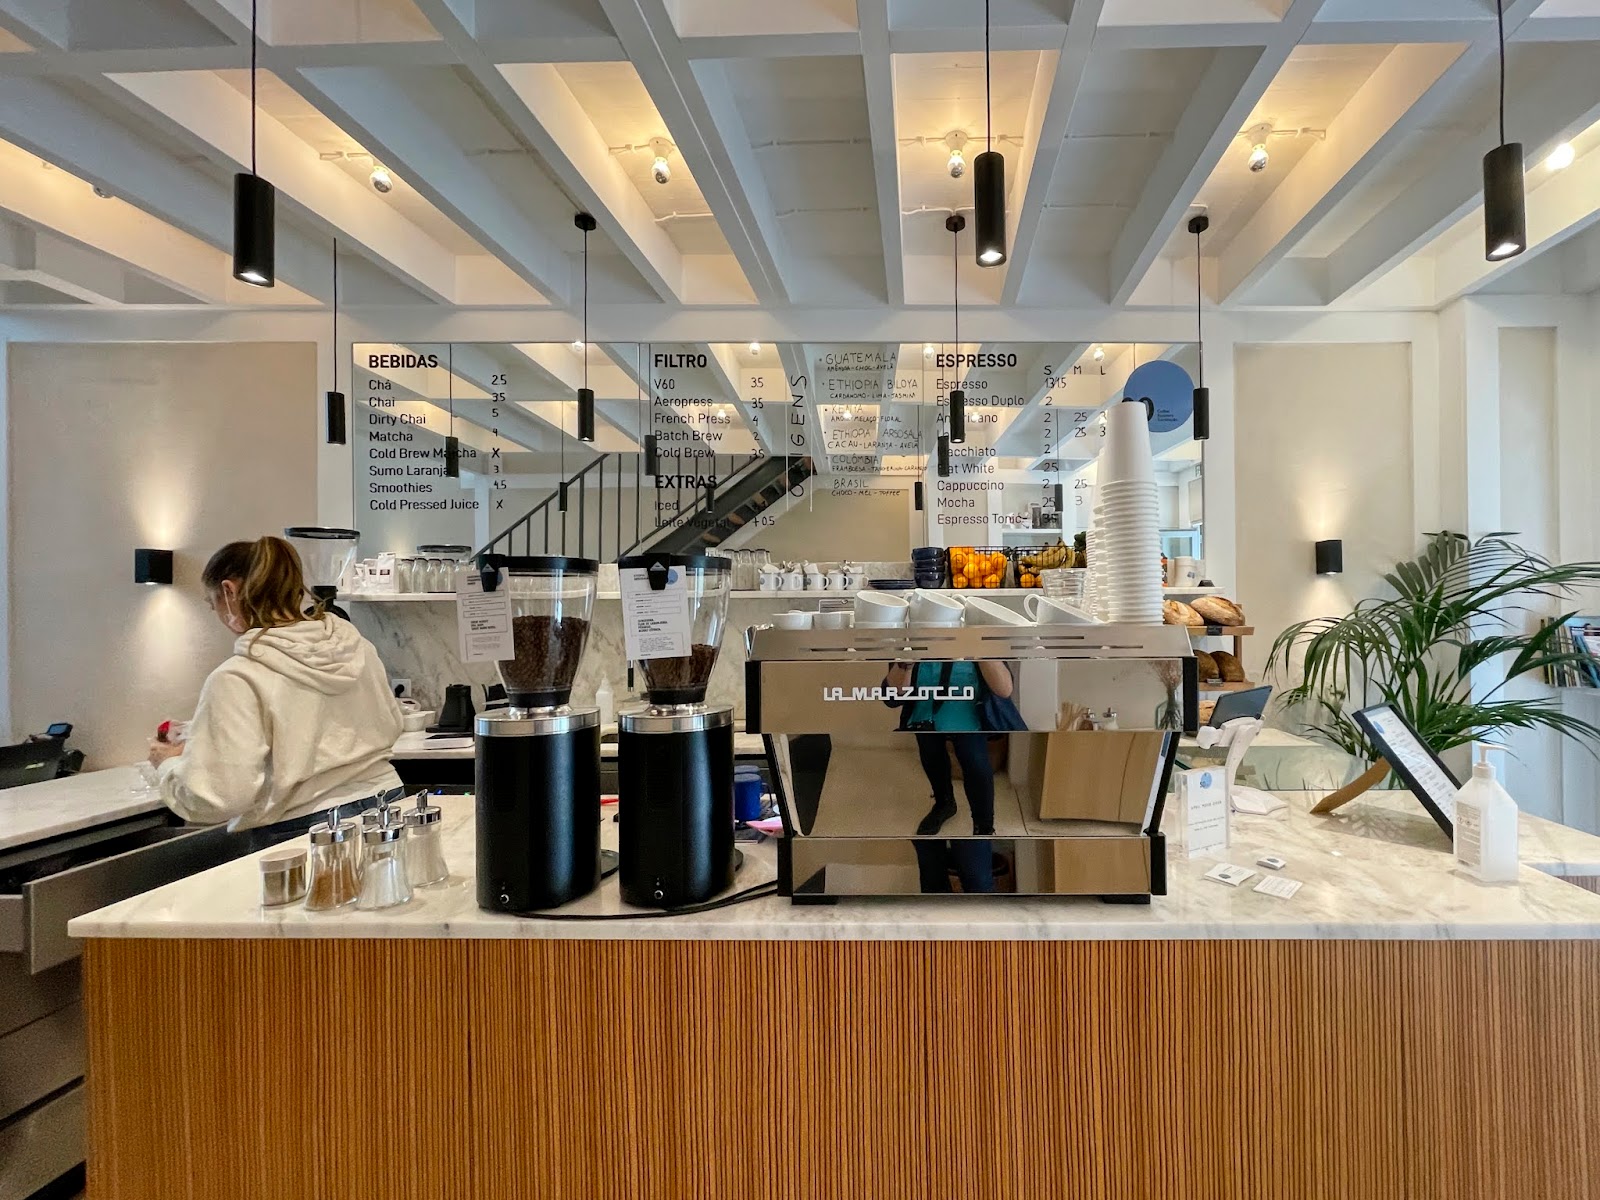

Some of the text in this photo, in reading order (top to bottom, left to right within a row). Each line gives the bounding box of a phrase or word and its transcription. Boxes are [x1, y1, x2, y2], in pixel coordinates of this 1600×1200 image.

[369, 355, 438, 368] BEBIDAS
[654, 354, 707, 368] FILTRO
[826, 352, 896, 365] GUATEMALA
[936, 354, 1017, 368] ESPRESSO
[1043, 365, 1052, 375] S
[1073, 365, 1082, 375] M
[1100, 365, 1106, 375] L
[369, 379, 391, 390] Chá
[654, 379, 675, 390] V60
[937, 379, 988, 391] Espresso
[369, 397, 395, 407] Chai
[654, 396, 713, 409] Aeropress
[937, 395, 1025, 408] Esesso Duplo
[1045, 396, 1052, 406] 2
[492, 408, 499, 418] 5
[654, 413, 731, 424] French Press
[1044, 412, 1051, 423] 2
[369, 414, 426, 426] Dirty Chai
[752, 415, 759, 427] 4
[369, 431, 413, 441] Matcha
[654, 430, 723, 441] Batch Brew
[753, 431, 760, 441] 2
[1044, 429, 1051, 439] 2
[1100, 427, 1106, 437] 3
[369, 448, 396, 458] Cold
[400, 448, 429, 458] Brew
[654, 447, 715, 458] Cold Brew
[937, 446, 996, 457] acchiato
[1044, 444, 1051, 454] 2
[369, 465, 403, 476] Sumo
[493, 465, 500, 473] 3
[962, 464, 995, 474] White
[369, 482, 432, 493] Smoothies
[655, 475, 717, 489] EXTRAS
[834, 478, 868, 489] BRASIL
[937, 481, 1005, 493] Cappuccino
[1042, 479, 1050, 489] 2
[370, 500, 479, 510] Cold Pressed Juice
[654, 500, 679, 511] Iced
[937, 497, 975, 508] Mocha
[1075, 496, 1083, 506] 3
[937, 513, 1022, 525] Espresso Tonic
[852, 686, 975, 700] MARZOCCO
